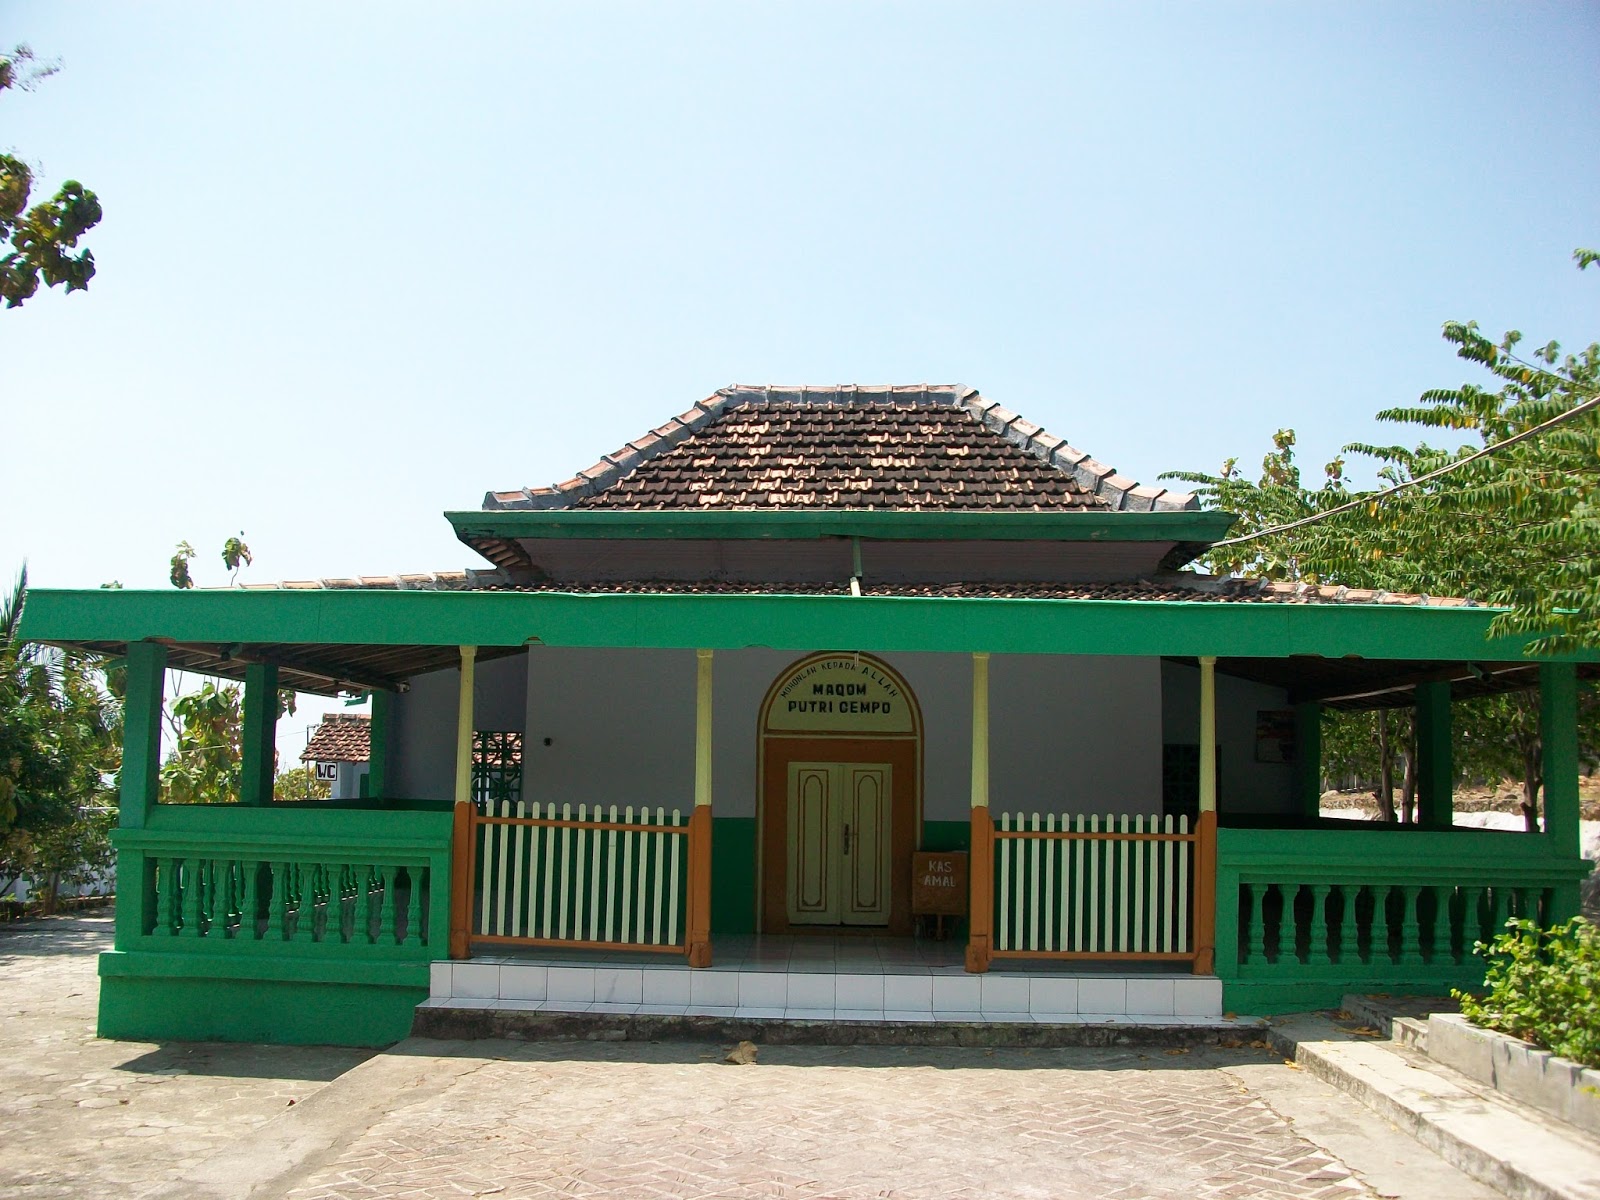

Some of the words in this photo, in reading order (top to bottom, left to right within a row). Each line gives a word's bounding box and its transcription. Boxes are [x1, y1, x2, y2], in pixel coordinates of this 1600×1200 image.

[780, 666, 817, 698] MOHONLAH
[821, 661, 856, 671] KEPADA
[861, 666, 898, 698] ALLAH
[813, 683, 867, 696] MAQOM
[788, 700, 833, 713] PUTRI
[839, 701, 891, 714] CEMPO
[317, 764, 335, 778] WC
[928, 860, 952, 873] KAS
[924, 875, 956, 887] AMAL
